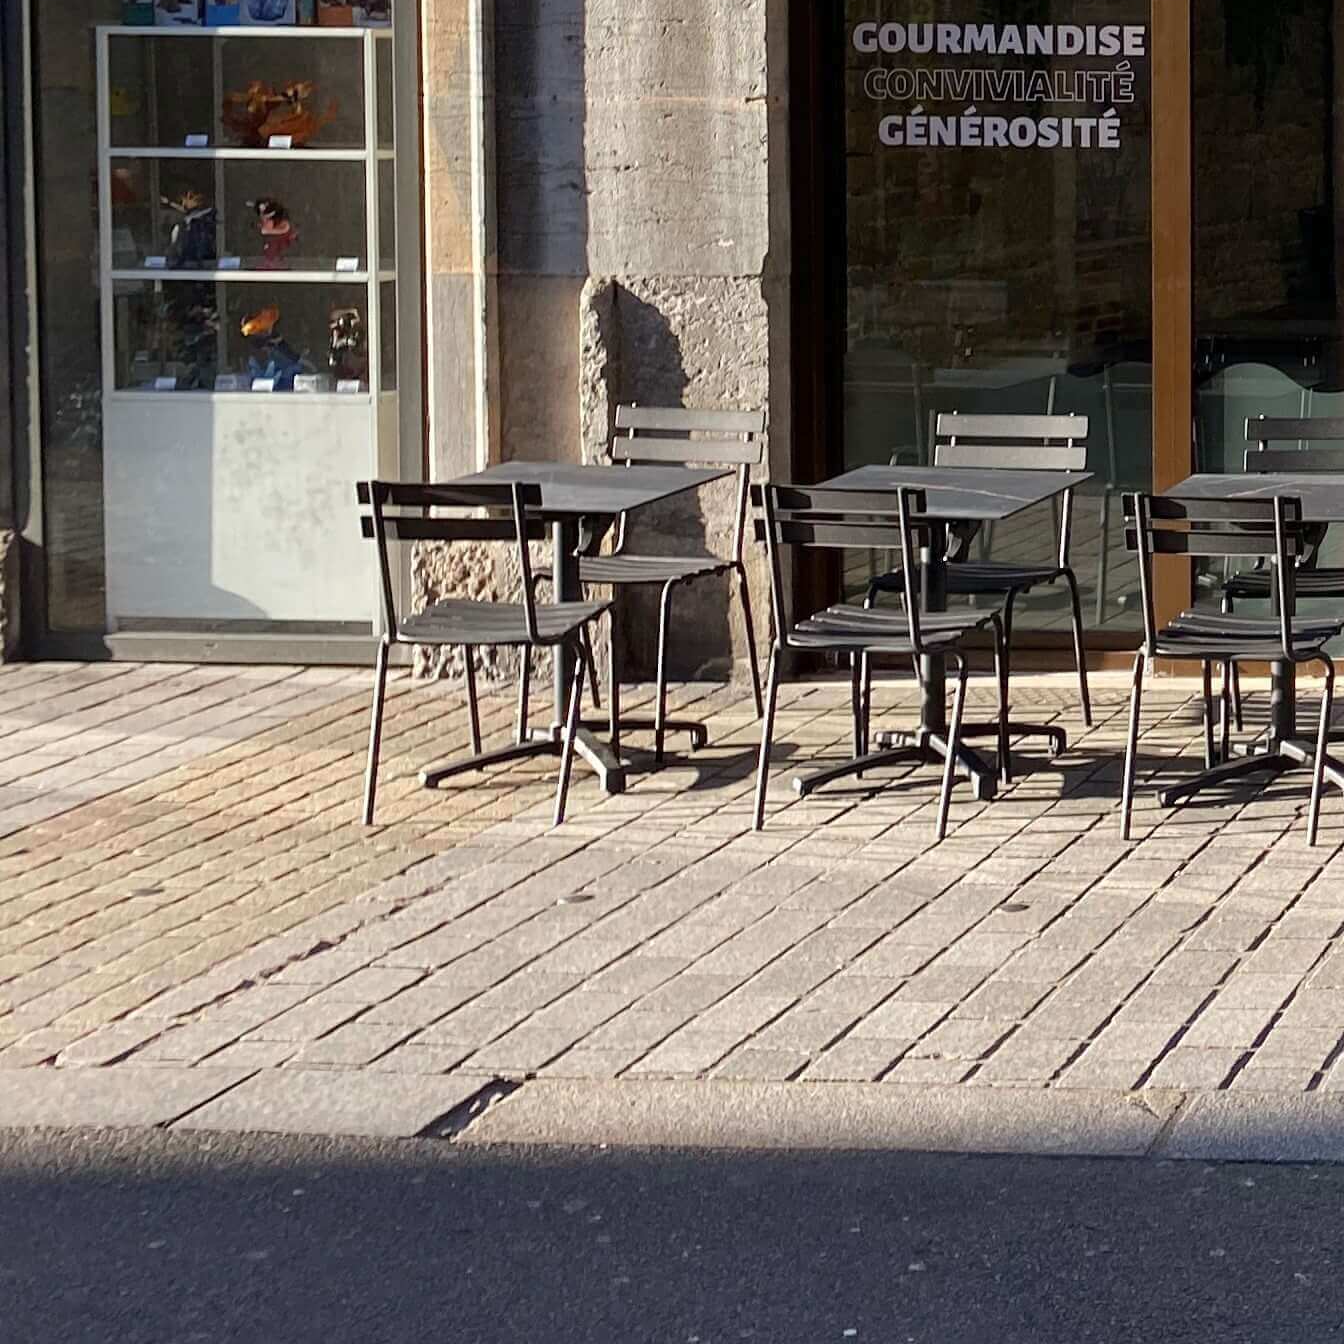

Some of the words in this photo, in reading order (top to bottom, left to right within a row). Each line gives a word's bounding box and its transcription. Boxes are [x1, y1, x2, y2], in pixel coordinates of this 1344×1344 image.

[853, 22, 1146, 56] GOURMANDISE
[863, 60, 1135, 103] CONVIVIALITÉ
[878, 104, 1121, 148] GÉNÉROSITÉ
